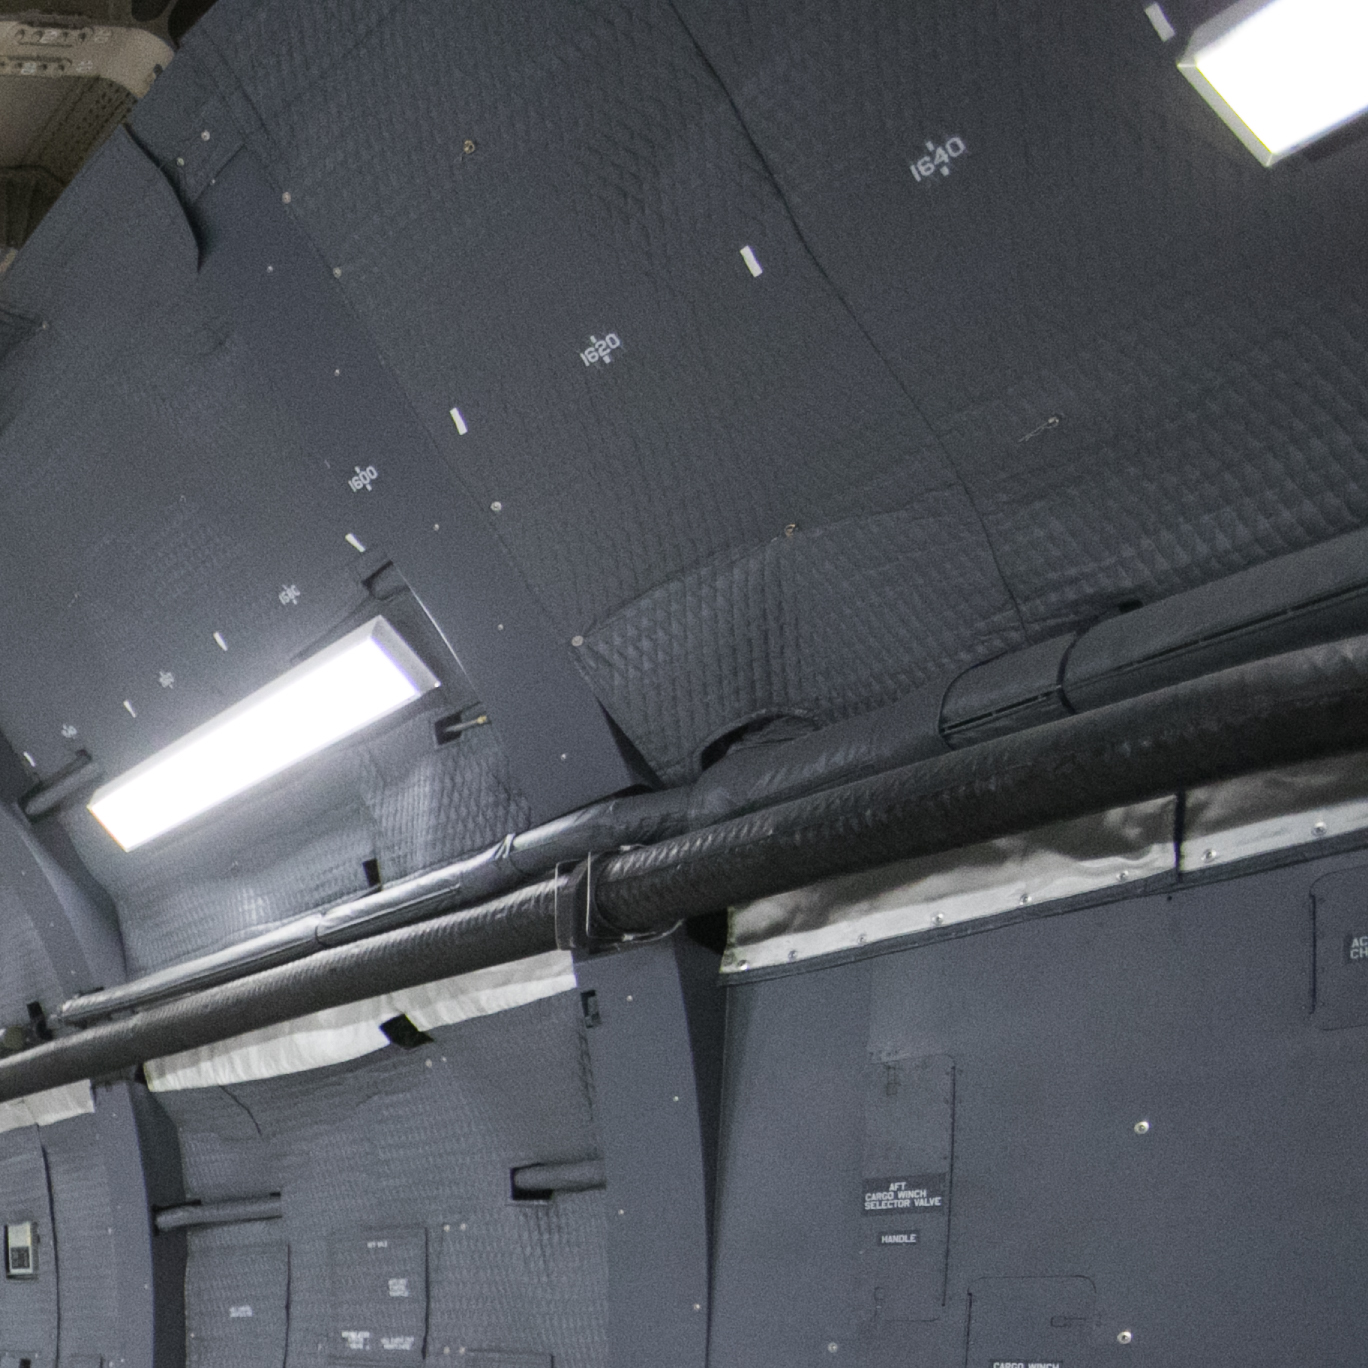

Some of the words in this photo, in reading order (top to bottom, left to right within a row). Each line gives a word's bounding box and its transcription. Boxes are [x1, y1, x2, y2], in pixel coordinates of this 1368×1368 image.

[909, 137, 966, 182] 1640
[579, 333, 621, 367] 1620
[348, 465, 378, 492] 1600
[889, 1182, 906, 1191] AFT
[865, 1192, 894, 1201] CARGO
[897, 1189, 927, 1199] WINCH
[864, 1199, 910, 1210] SELECTOR
[914, 1197, 942, 1207] VALVE
[881, 1234, 917, 1243] HANDLE
